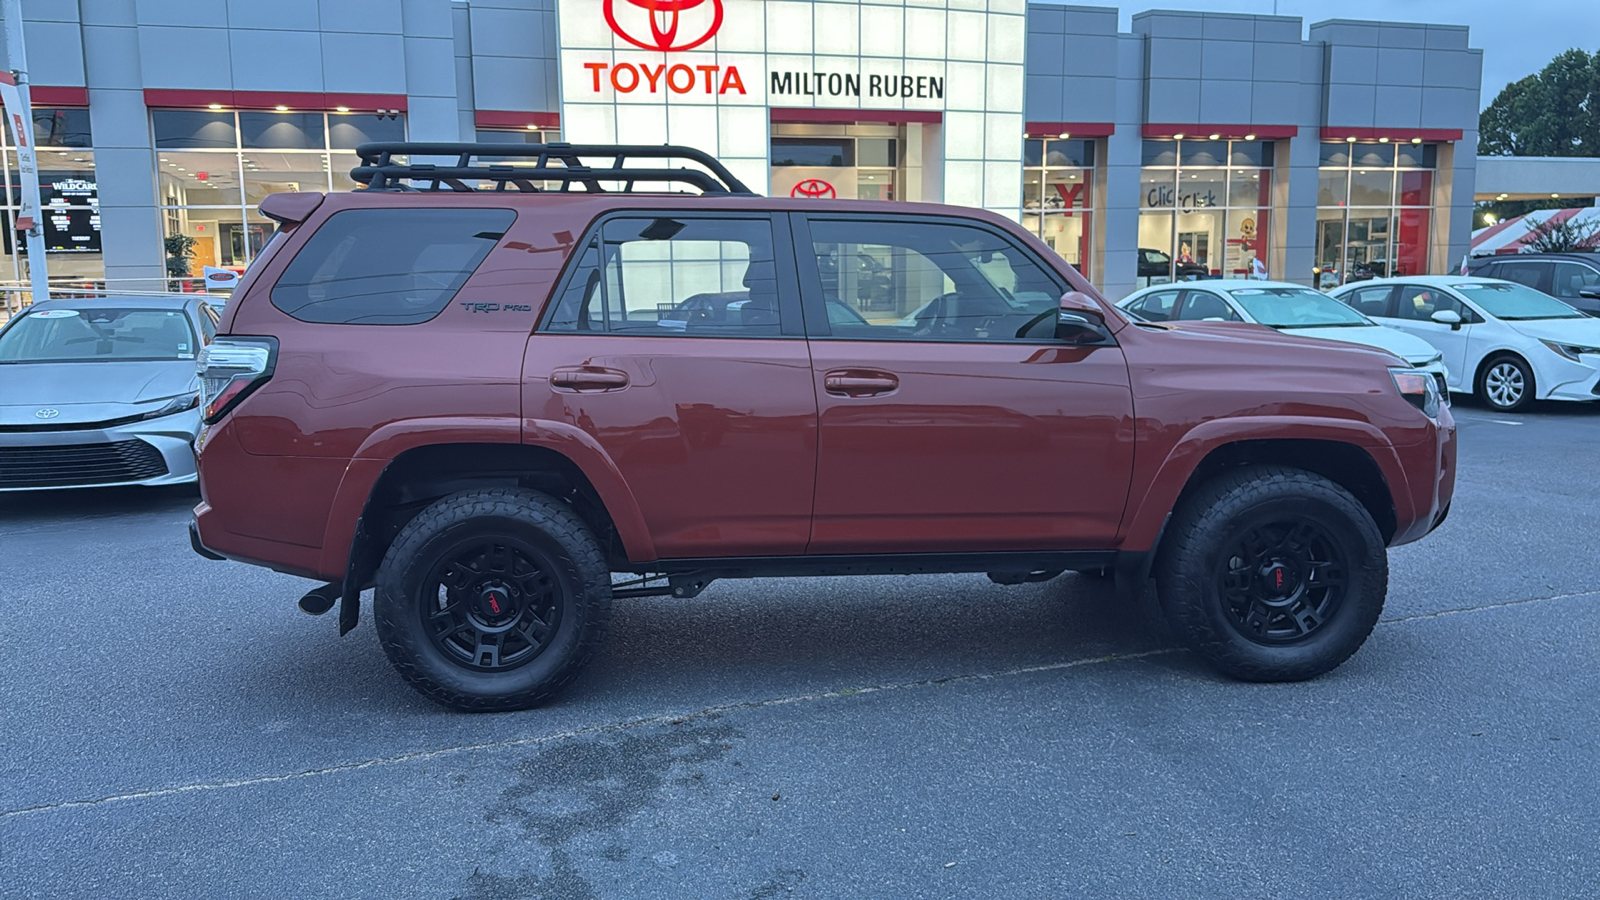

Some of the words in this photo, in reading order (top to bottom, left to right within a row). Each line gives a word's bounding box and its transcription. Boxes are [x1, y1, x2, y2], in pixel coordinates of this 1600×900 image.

[584, 62, 747, 95] TOYOTA
[771, 71, 860, 97] MILTON
[869, 74, 944, 99] RUBEN
[1147, 185, 1182, 208] Clic
[460, 302, 500, 313] TRD
[503, 303, 532, 312] PRO
[489, 592, 500, 613] TRD
